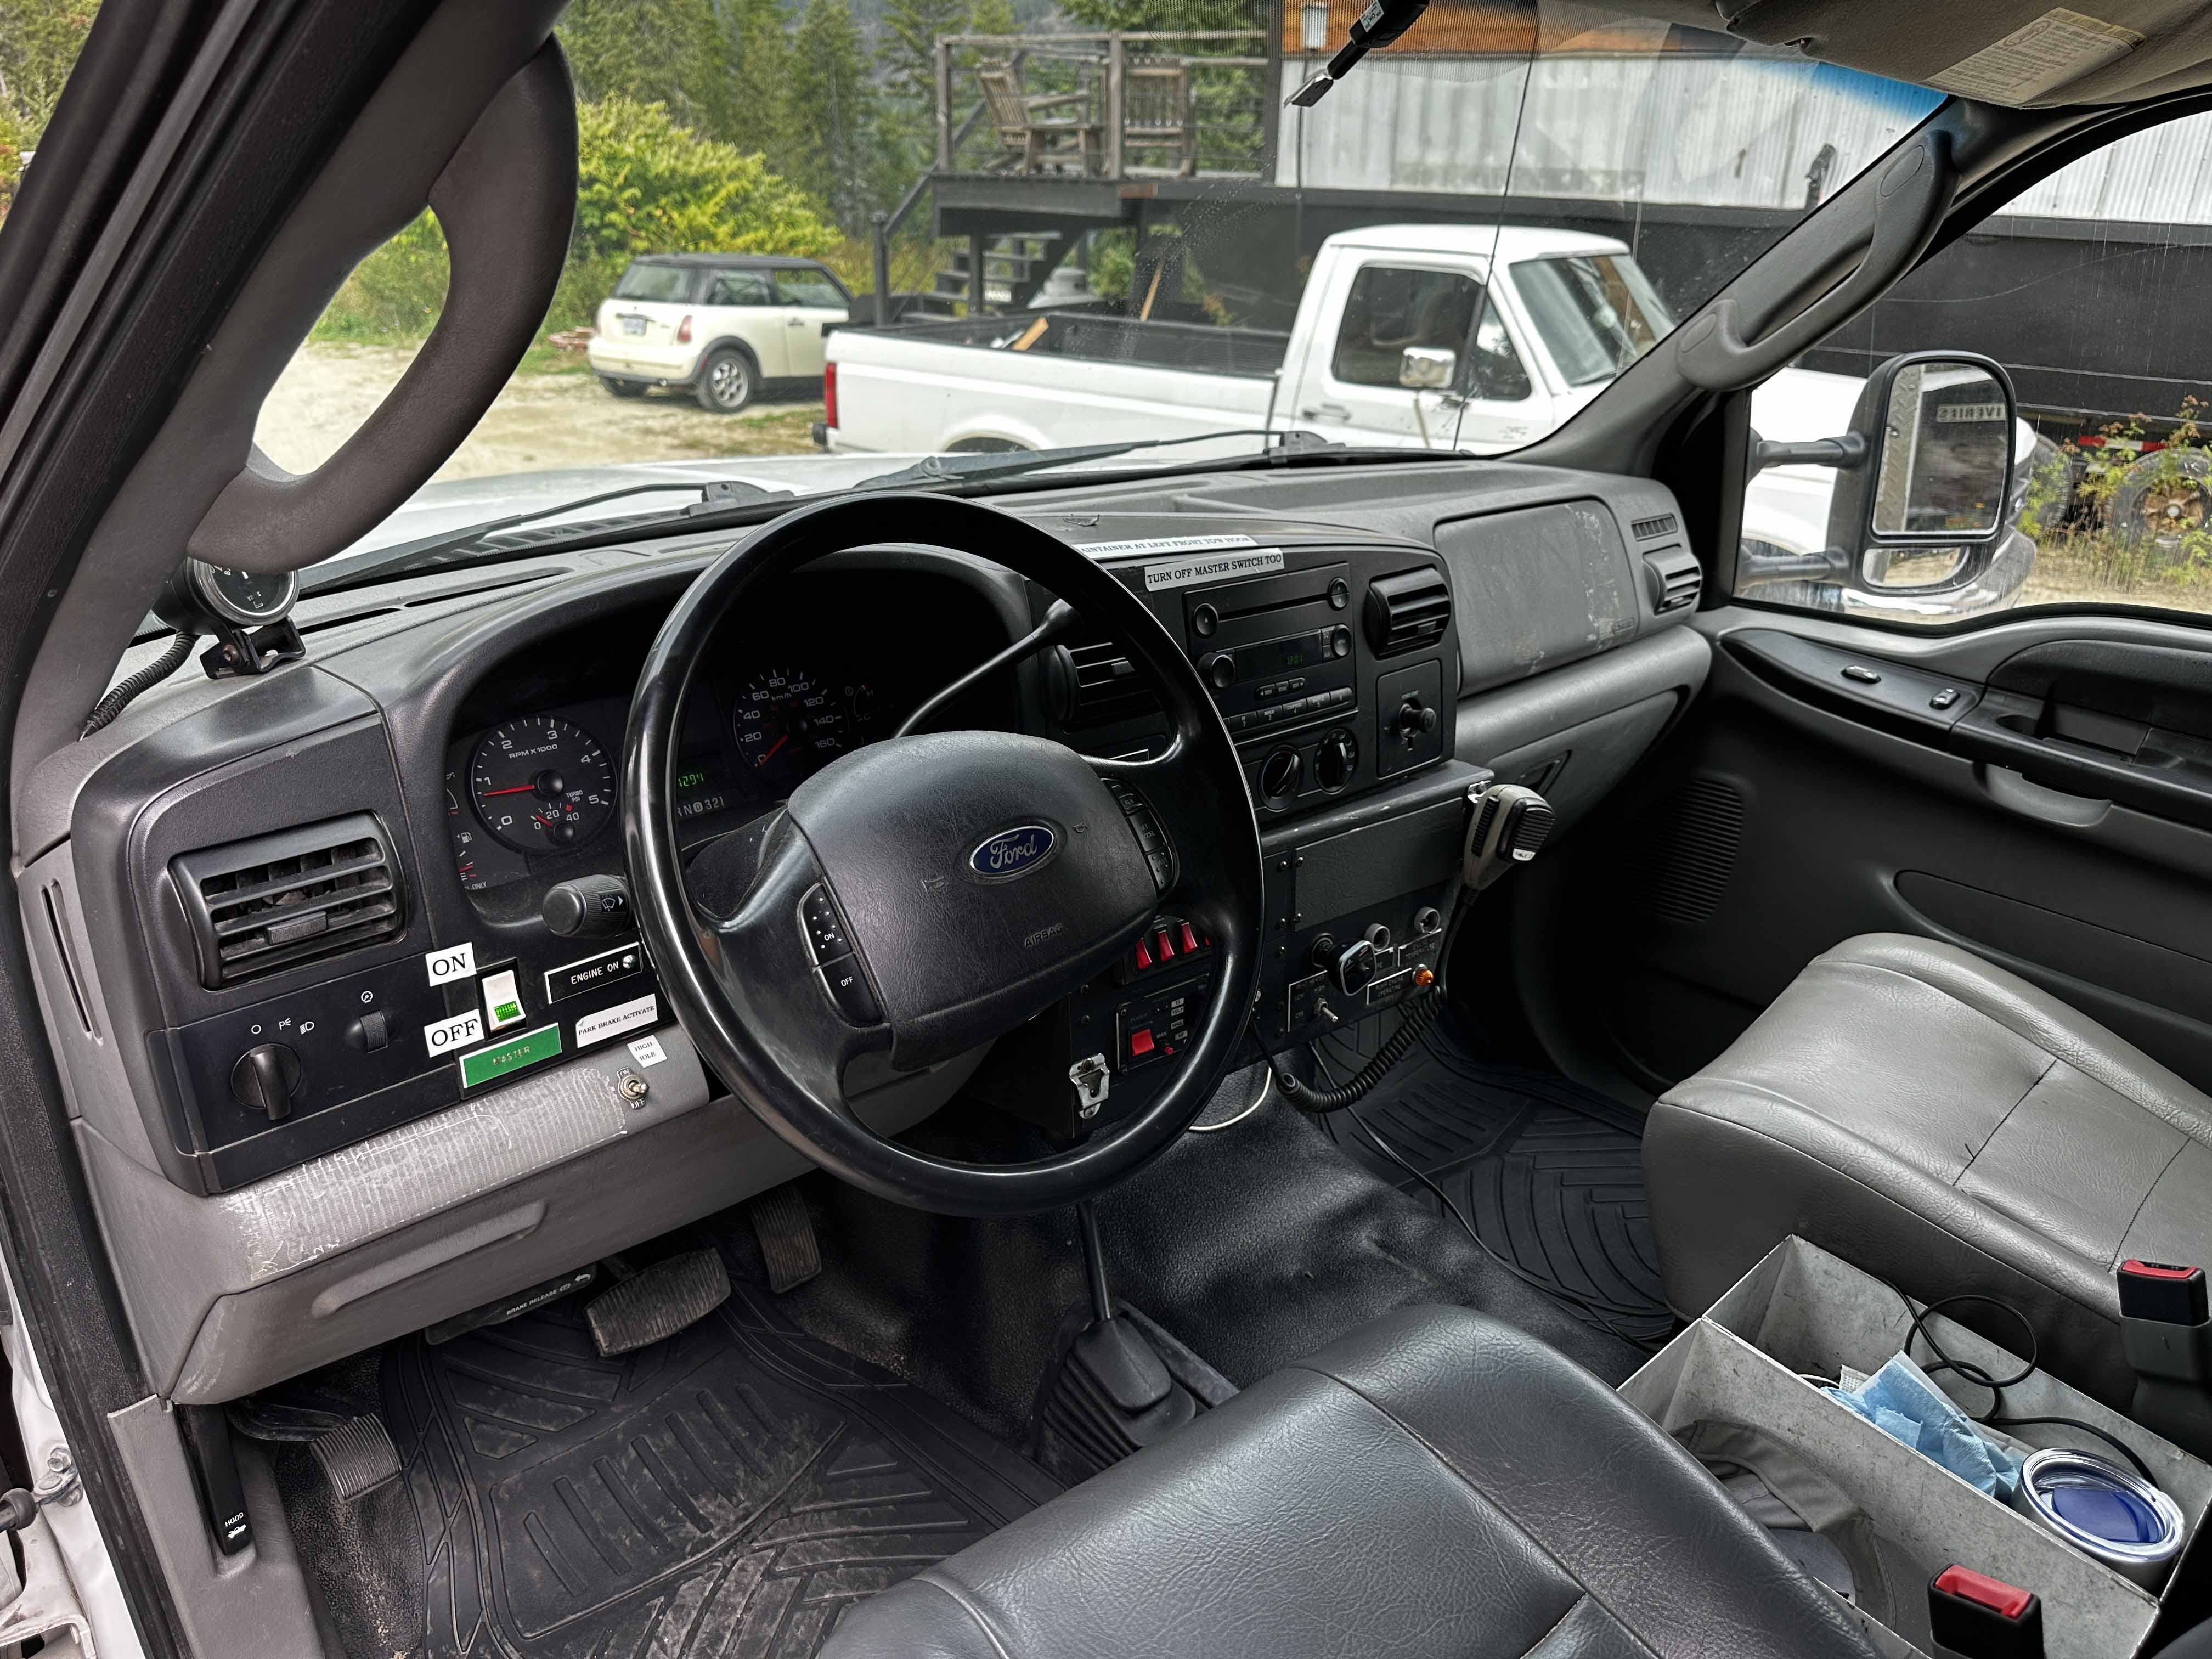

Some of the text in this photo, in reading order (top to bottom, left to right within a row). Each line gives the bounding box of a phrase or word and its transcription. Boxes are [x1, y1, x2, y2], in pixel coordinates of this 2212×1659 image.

[1081, 543, 1133, 554] AINTAINER
[1147, 554, 1282, 584] TURN OFF MASTER SWITCH TOO
[769, 677, 786, 687] 80
[788, 682, 809, 693] 100
[752, 690, 769, 701] 60
[771, 692, 792, 701] km/h
[803, 696, 823, 707] 120
[743, 710, 760, 720] 40
[814, 715, 834, 725] 140
[546, 730, 558, 740] 3
[744, 731, 762, 742] 20
[501, 740, 513, 750] 2
[815, 737, 835, 748] 160
[509, 750, 529, 759] RPM
[580, 754, 591, 763] 4
[484, 776, 492, 786] 1
[566, 789, 583, 798] TURBO
[588, 794, 599, 804] 5
[546, 809, 560, 820] 20
[566, 812, 580, 821] 40
[501, 815, 513, 826] 0
[534, 822, 541, 830] 0
[989, 833, 1037, 869] Ford
[472, 881, 487, 890] ONLY
[823, 932, 836, 942] ON
[1024, 923, 1063, 948] AIRBAG
[432, 952, 466, 976] ON
[571, 961, 619, 985] ENGINE ON
[840, 976, 854, 987] OFF
[578, 1005, 655, 1036] PARK BRAKE ACTIVATE
[431, 1018, 478, 1047] OFF
[492, 1046, 531, 1065] MASTER
[639, 1052, 656, 1061] IDLE
[620, 1068, 631, 1077] ON
[630, 1098, 645, 1109] OFF
[506, 1289, 557, 1316] BRAKE RELEASE
[225, 1512, 244, 1527] HOOD
